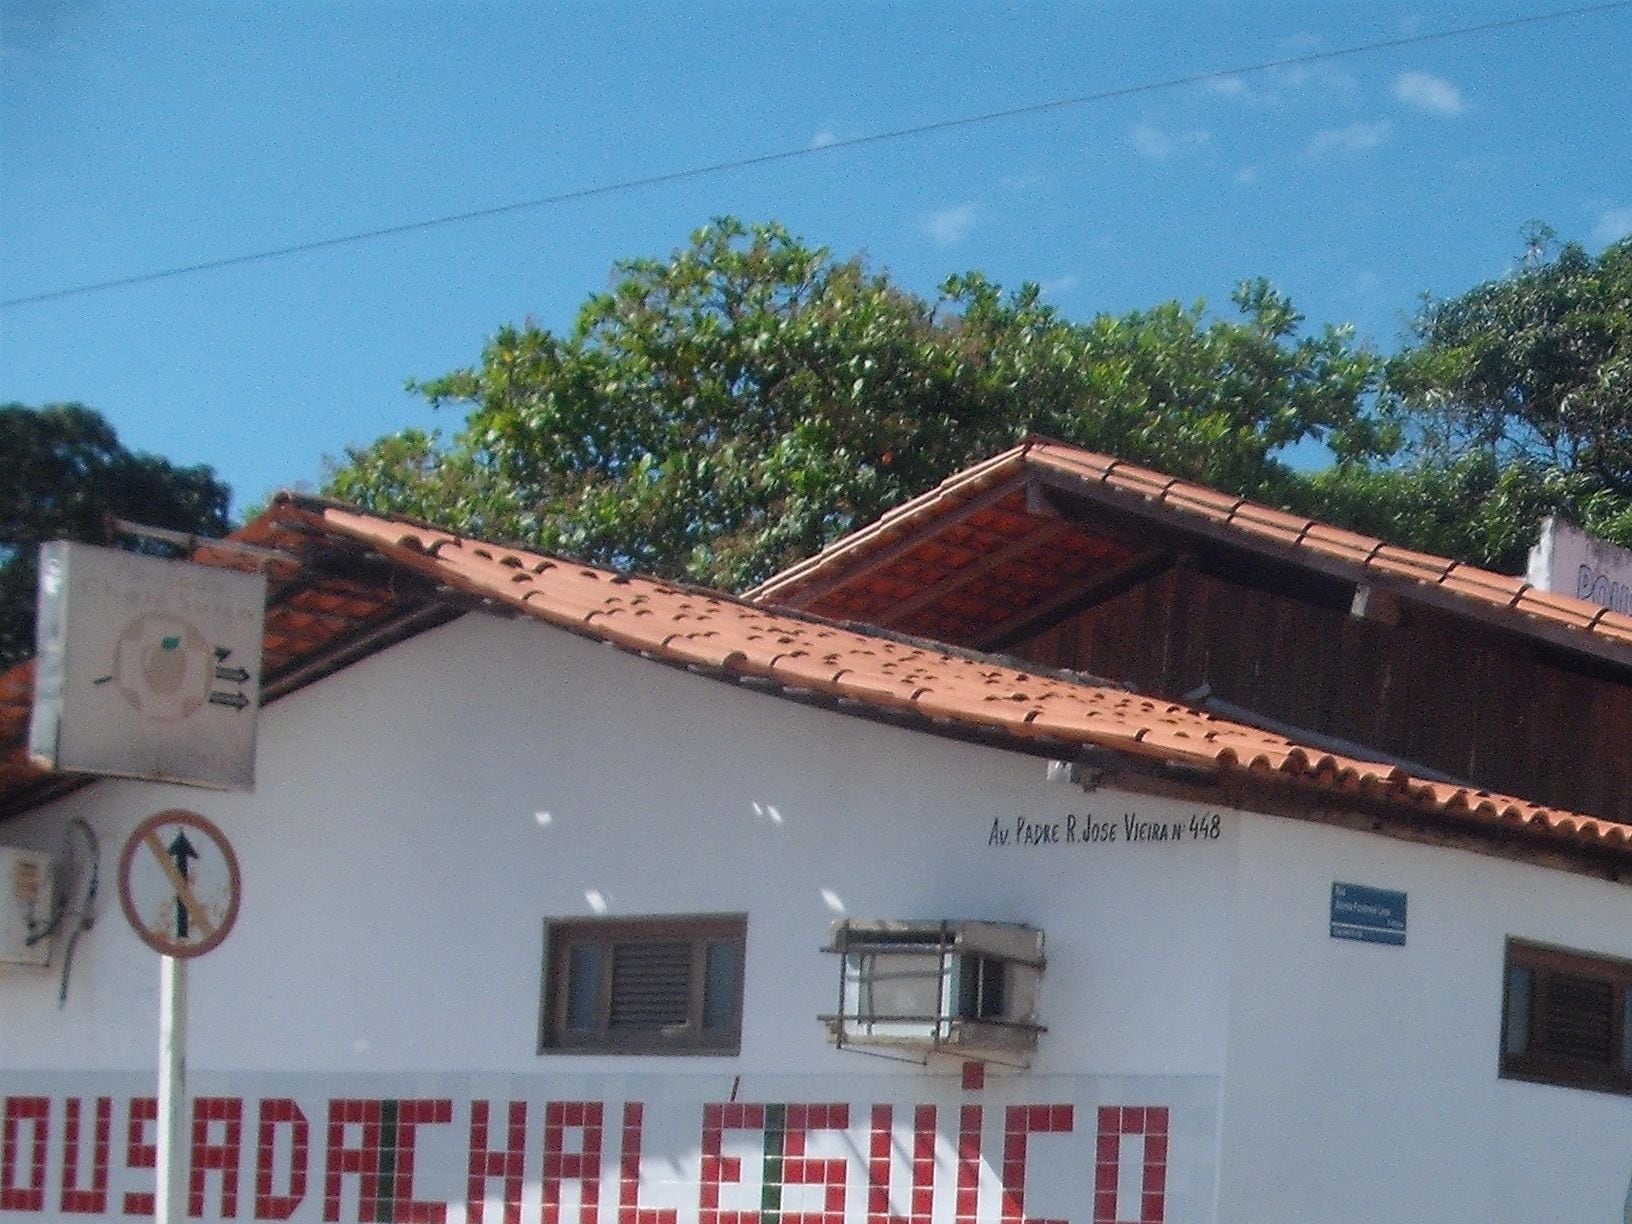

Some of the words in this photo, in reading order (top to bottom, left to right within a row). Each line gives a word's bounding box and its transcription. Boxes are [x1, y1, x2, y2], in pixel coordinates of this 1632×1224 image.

[1016, 815, 1060, 846] PADRE
[1082, 812, 1118, 843] JOSE
[1124, 812, 1168, 842] VIEIRA
[1189, 811, 1222, 840] 448
